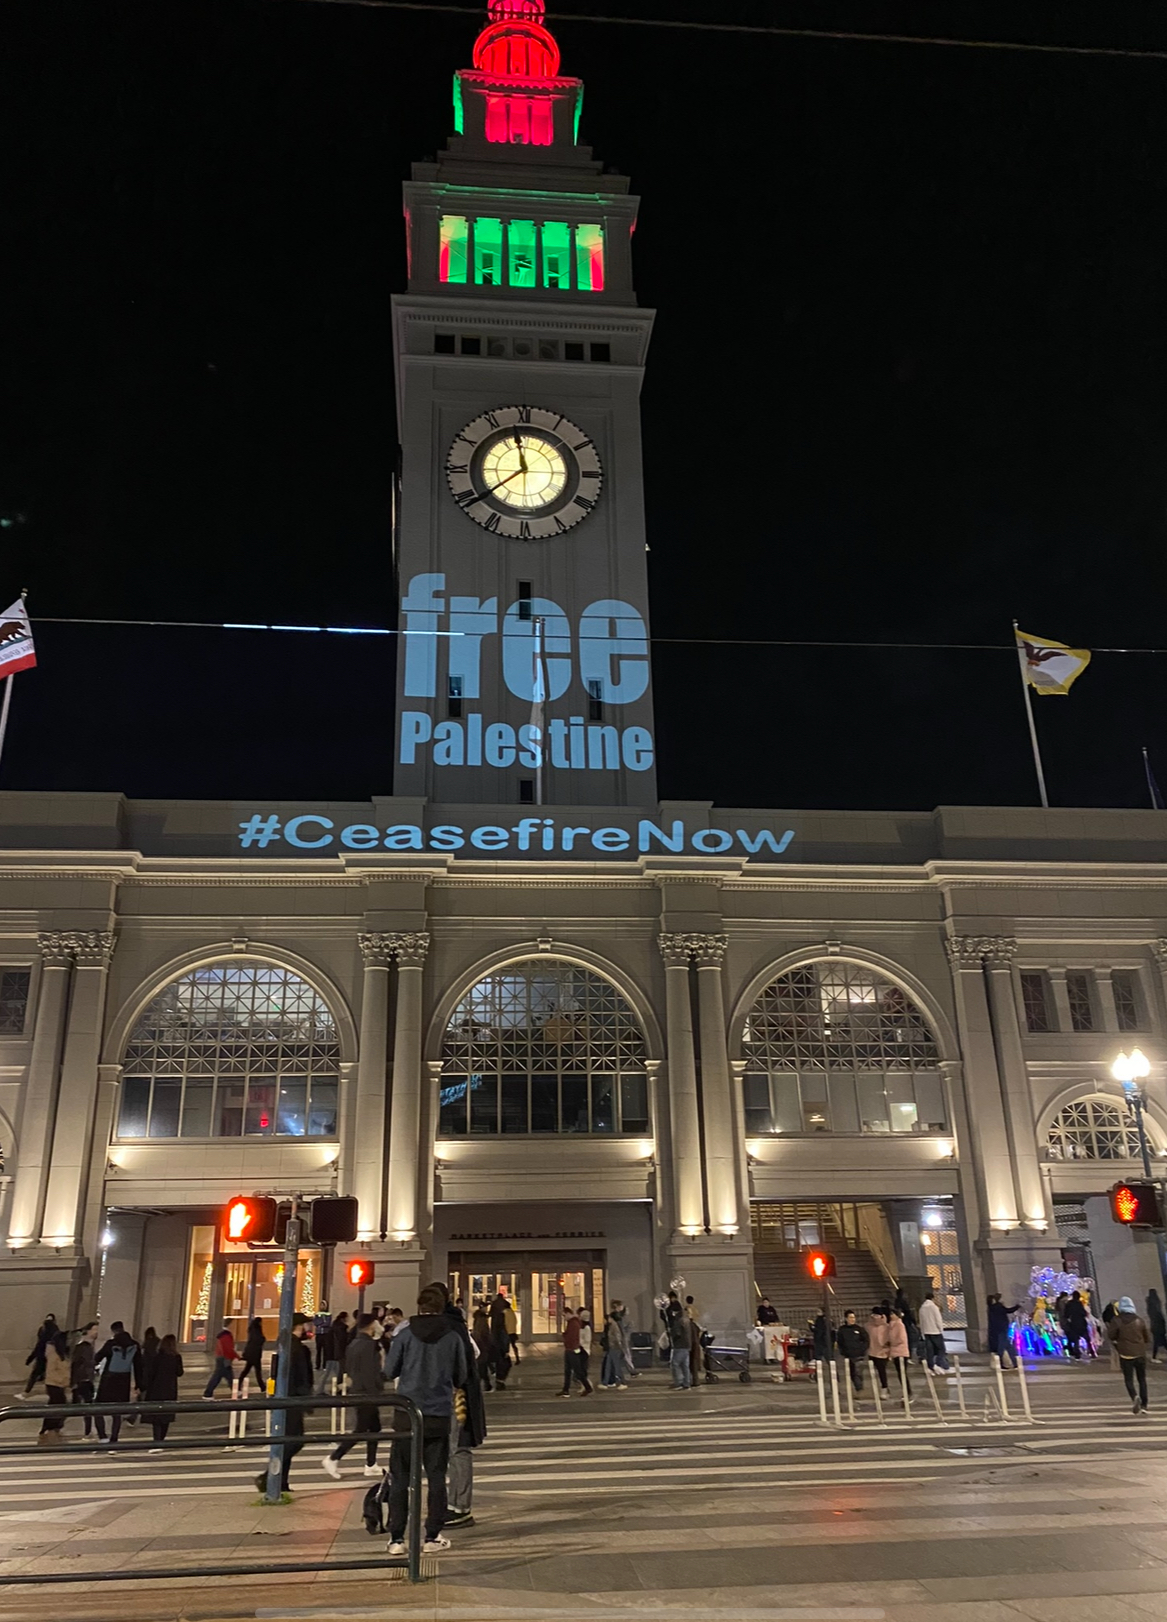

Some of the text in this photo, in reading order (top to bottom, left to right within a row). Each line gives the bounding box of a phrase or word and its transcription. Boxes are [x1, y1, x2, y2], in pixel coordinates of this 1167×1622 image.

[484, 413, 500, 430] XI
[517, 407, 531, 424] XII
[552, 417, 563, 431] I
[458, 435, 477, 448] X
[573, 439, 593, 451] II
[449, 464, 468, 473] IX
[582, 470, 600, 479] III
[520, 520, 531, 537] VI
[553, 515, 566, 531] V
[402, 573, 650, 705] free
[400, 711, 654, 772] Palestine
[239, 815, 795, 854] #CeasefireNow
